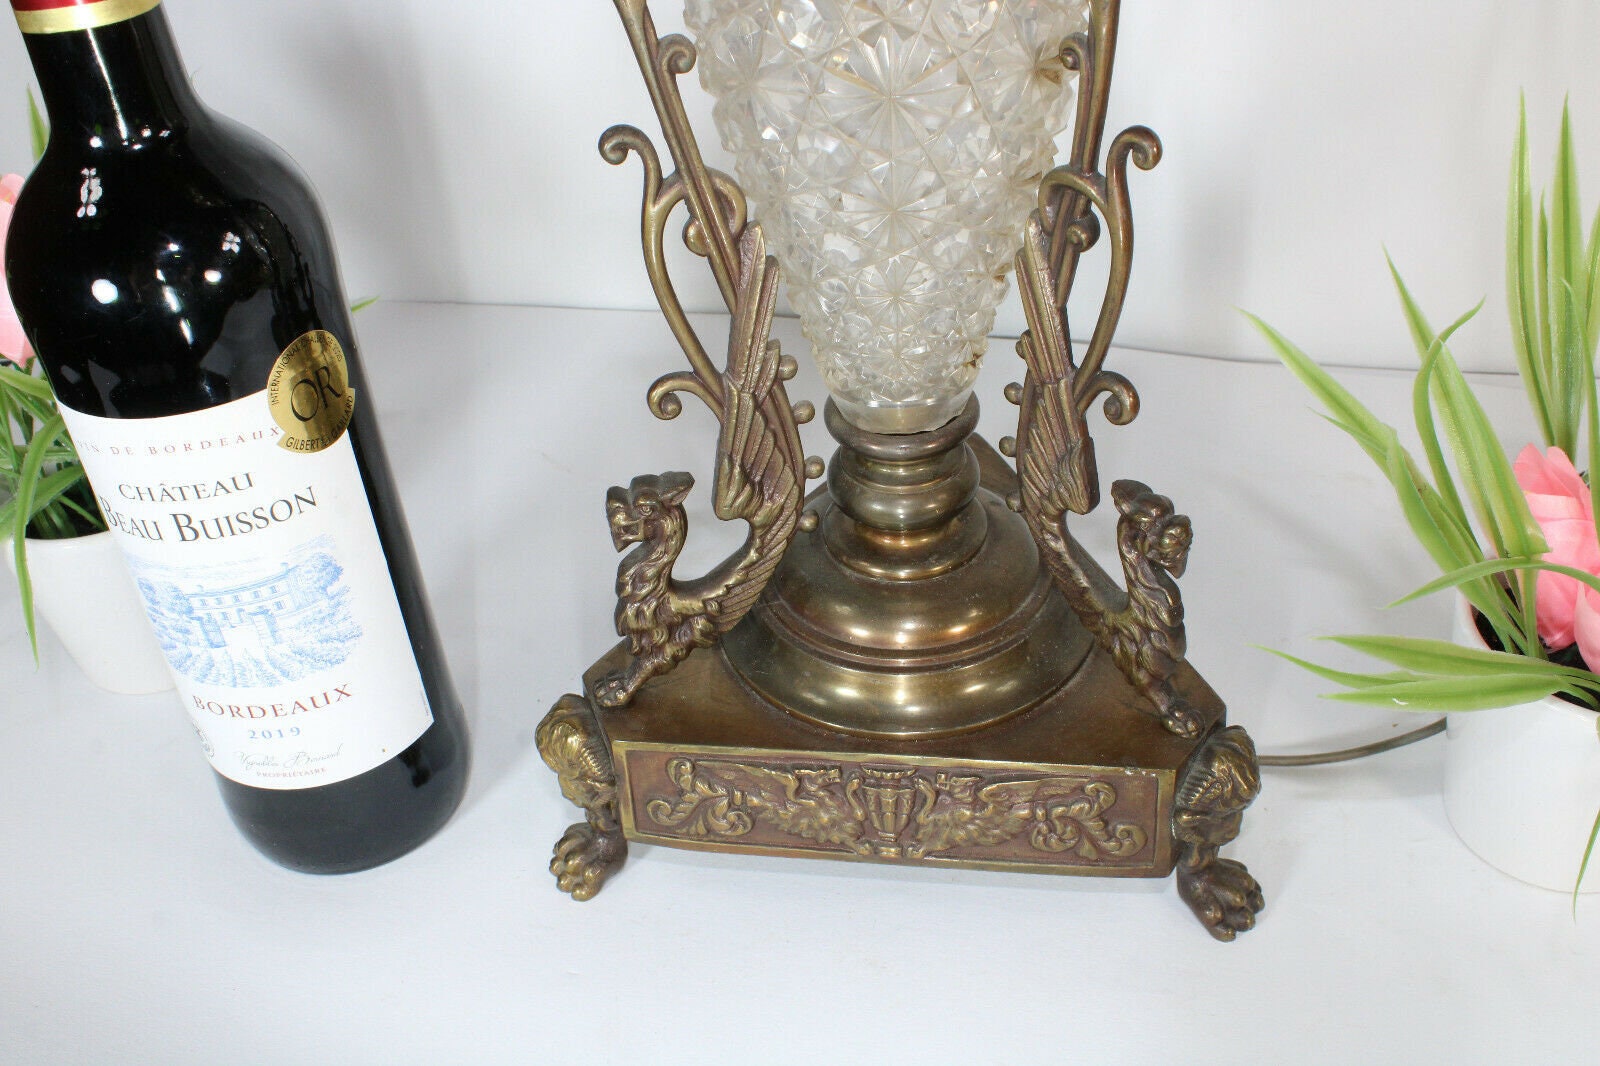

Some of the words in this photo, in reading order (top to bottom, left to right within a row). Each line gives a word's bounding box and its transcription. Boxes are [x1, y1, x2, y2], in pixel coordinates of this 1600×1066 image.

[291, 366, 341, 422] OR
[110, 446, 134, 456] DE
[148, 427, 280, 456] BORDEAUX
[286, 436, 321, 451] GILBERT
[118, 472, 254, 503] CHÂTEAU
[192, 683, 353, 720] BORDEAUX
[249, 726, 301, 739] 2019
